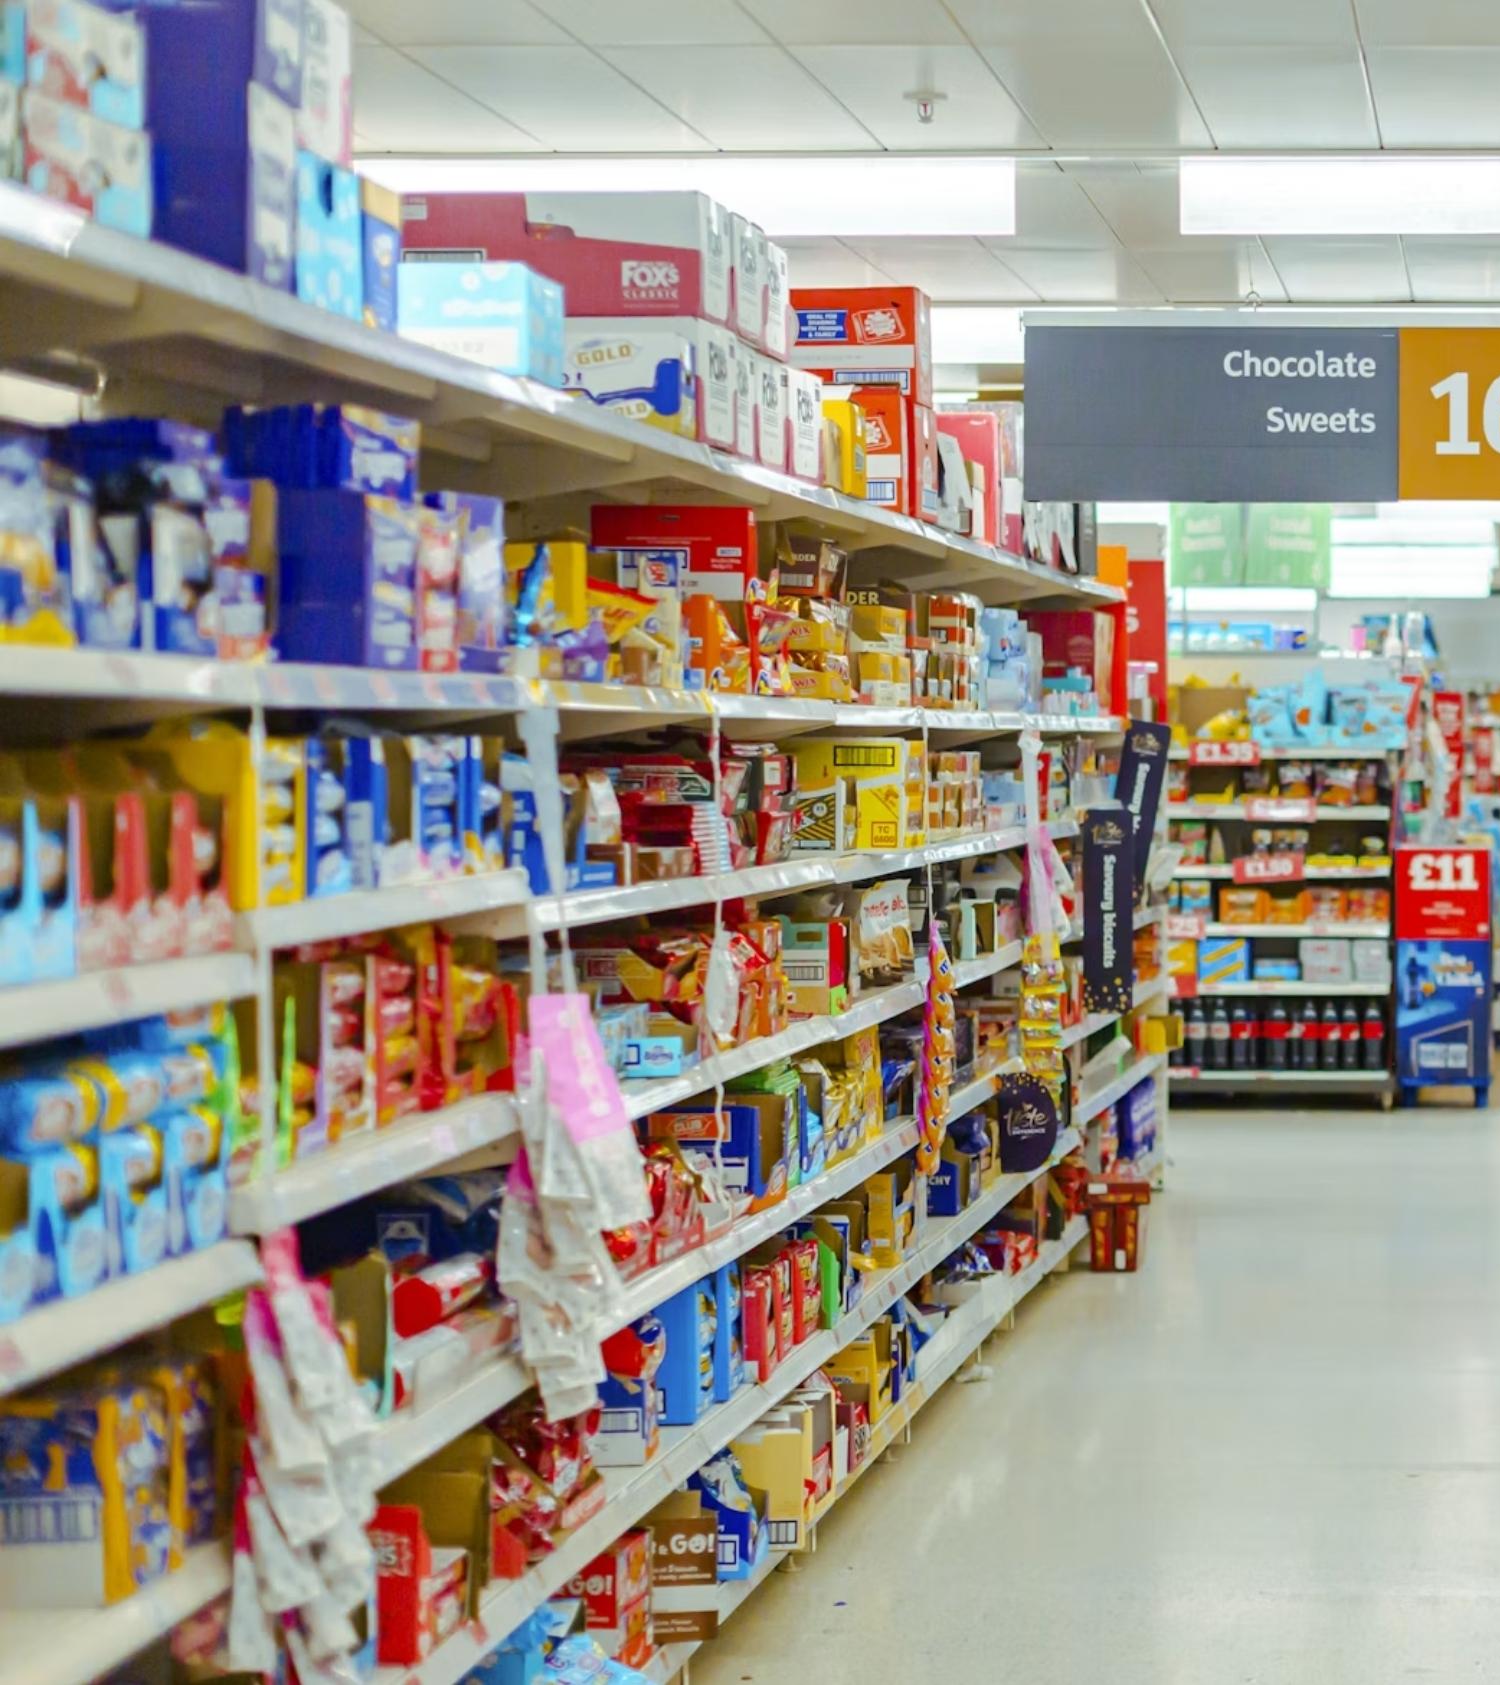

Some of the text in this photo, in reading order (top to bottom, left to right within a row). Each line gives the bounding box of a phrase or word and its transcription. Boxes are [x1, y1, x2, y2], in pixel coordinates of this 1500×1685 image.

[623, 289, 679, 299] CLASSIC
[576, 344, 631, 365] GOLD
[1223, 351, 1376, 378] Chocolate
[1266, 406, 1376, 434] Sweets
[847, 591, 880, 605] DER
[1100, 854, 1117, 911] Savoury
[1408, 854, 1479, 891] £11
[1103, 912, 1117, 969] biscuits
[928, 1176, 951, 1186] CHY
[670, 1532, 715, 1555] GO!
[567, 1573, 614, 1596] GO!
